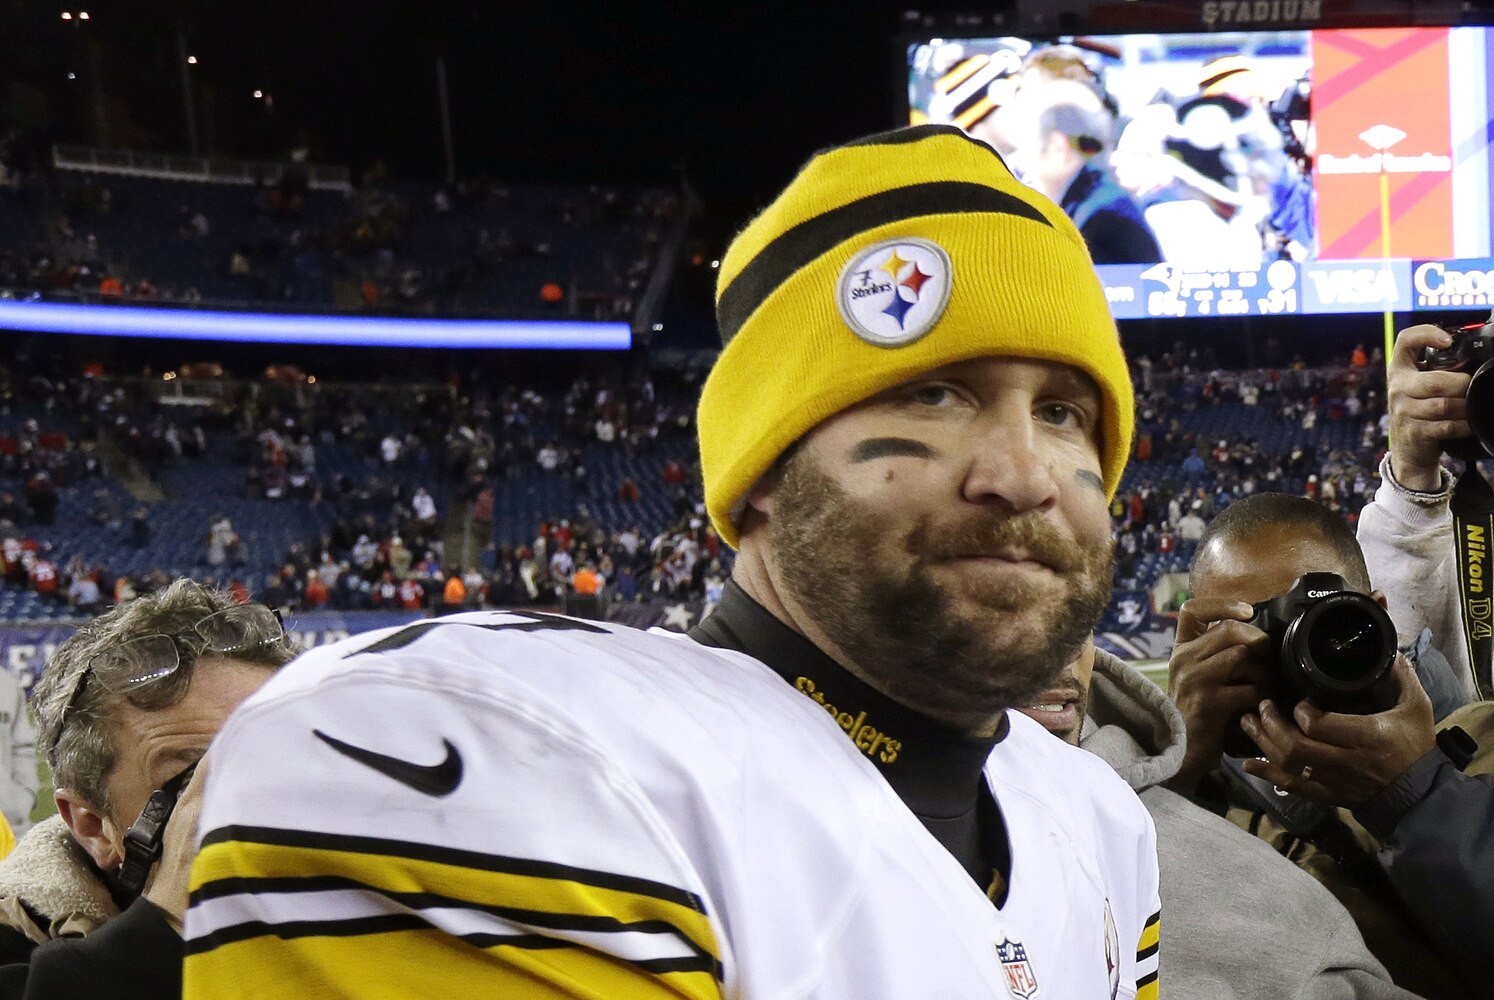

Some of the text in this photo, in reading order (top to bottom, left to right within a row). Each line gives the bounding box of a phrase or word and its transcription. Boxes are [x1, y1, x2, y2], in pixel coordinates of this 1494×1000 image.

[1202, 0, 1321, 23] STADIUM
[851, 282, 893, 300] Steelers
[1308, 269, 1400, 304] VISA
[1466, 524, 1493, 640] Nikon D4
[1307, 590, 1339, 599] Can
